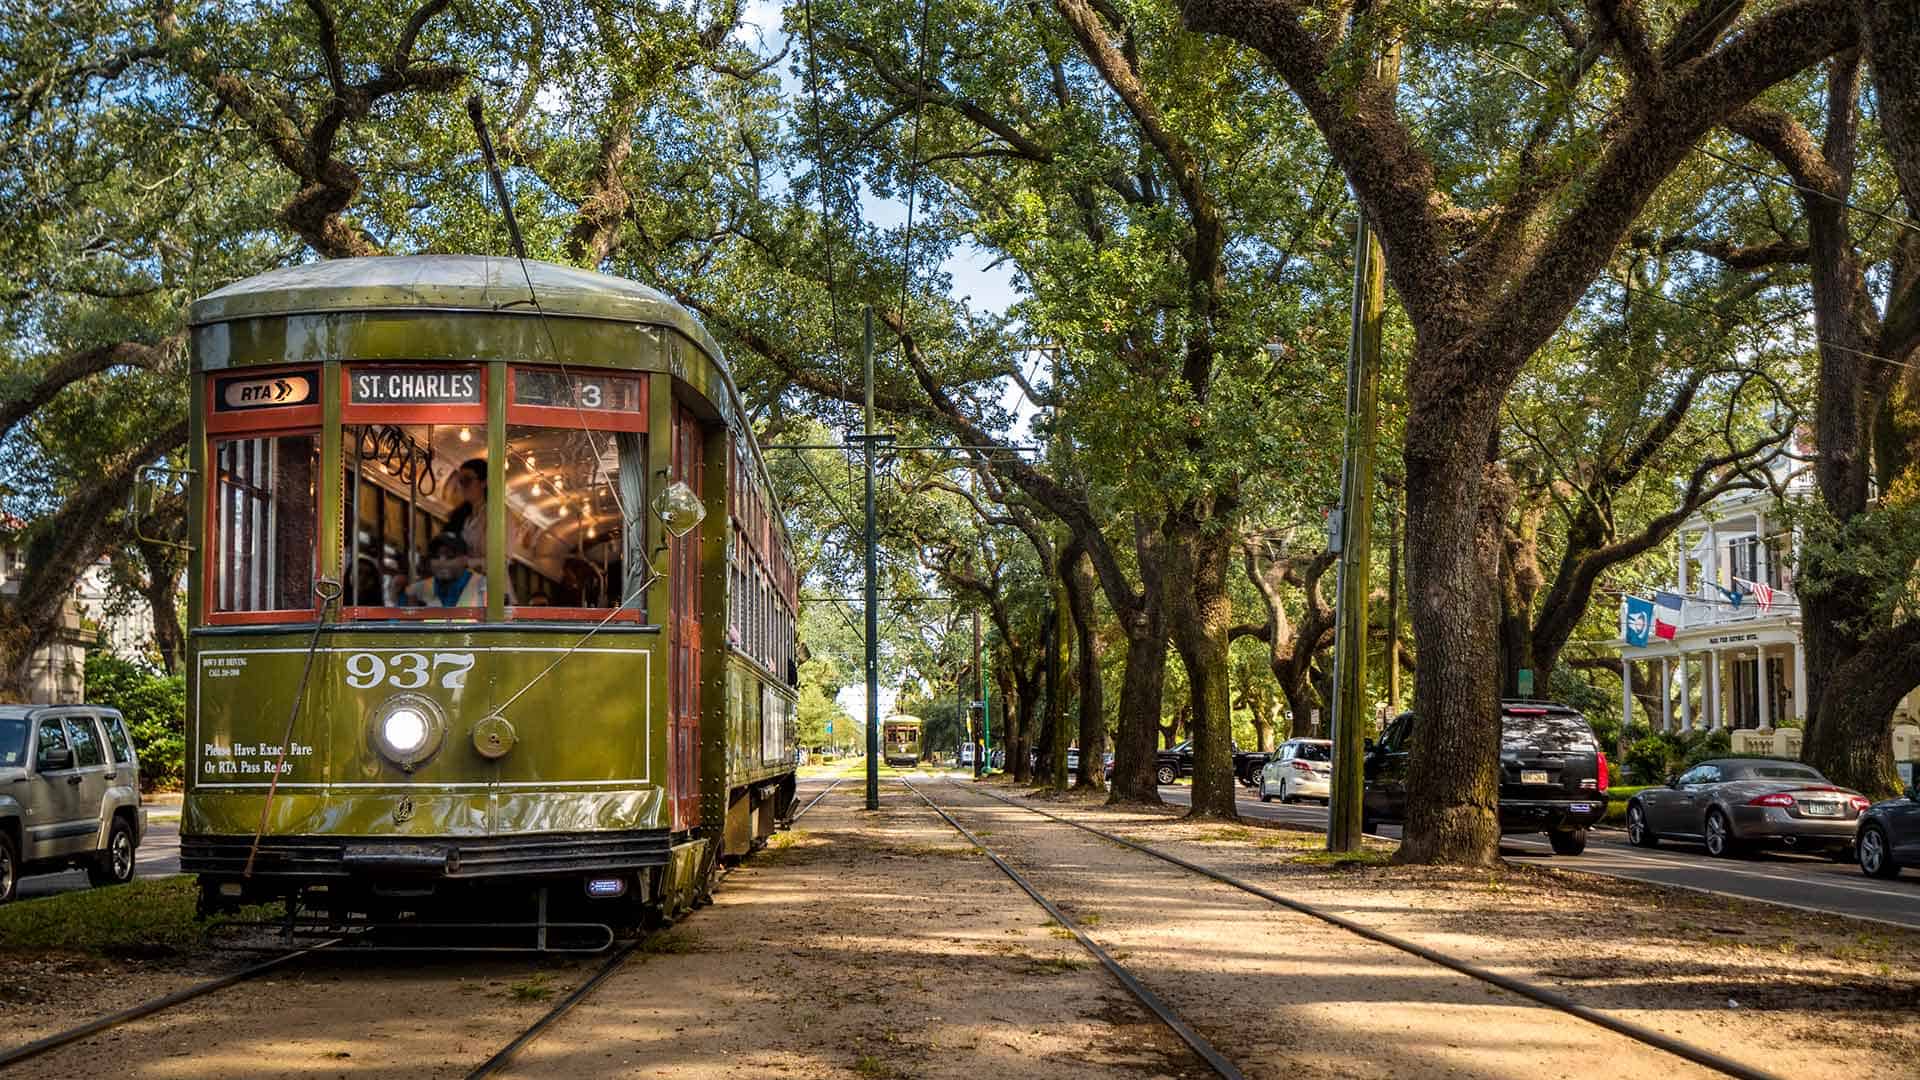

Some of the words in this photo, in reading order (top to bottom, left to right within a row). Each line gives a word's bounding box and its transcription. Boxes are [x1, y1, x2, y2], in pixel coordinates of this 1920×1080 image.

[241, 385, 271, 400] RTA
[359, 375, 384, 397] ST.
[388, 374, 473, 397] CHARLES
[582, 384, 601, 407] 3
[346, 653, 476, 689] 937
[234, 744, 257, 756] Have
[291, 742, 312, 755] Fare
[205, 761, 216, 773] Or
[219, 761, 238, 773] RTA
[241, 761, 260, 773] Pass
[264, 761, 293, 775] Redy
